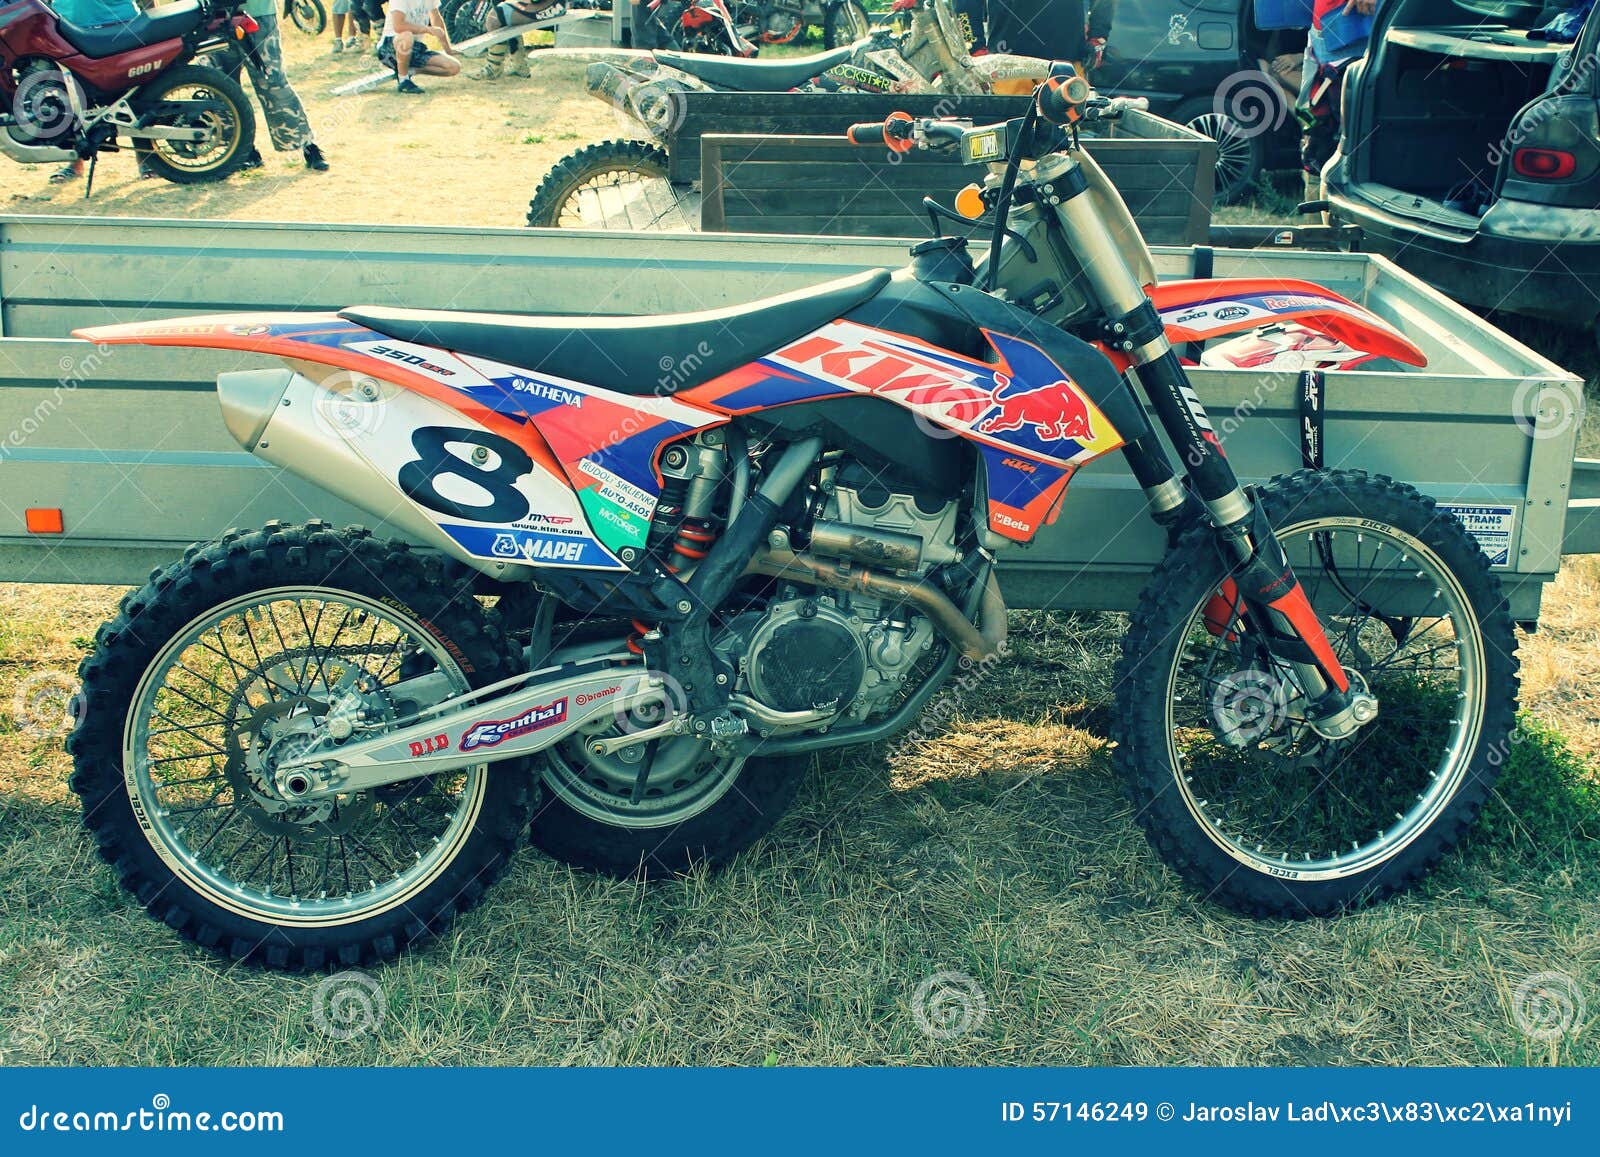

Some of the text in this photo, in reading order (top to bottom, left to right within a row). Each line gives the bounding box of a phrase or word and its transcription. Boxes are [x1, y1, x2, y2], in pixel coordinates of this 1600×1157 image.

[127, 62, 153, 78] 600
[368, 345, 427, 365] 350
[775, 336, 994, 422] KTM
[523, 381, 582, 409] ATHENA
[1001, 457, 1037, 474] KTM
[397, 425, 534, 524] 8
[528, 513, 574, 526] MXGP
[598, 507, 641, 537] MOTOREX
[1002, 515, 1031, 532] Beta
[1360, 519, 1393, 534] EXCEL
[1456, 514, 1503, 524] NI-TRANS
[511, 522, 584, 536] www.ktm.com
[524, 537, 585, 562] MAPEI
[586, 686, 622, 702] brembo
[464, 702, 565, 748] Renthal
[130, 793, 152, 830] EXCEL
[1266, 865, 1299, 879] EXCEL
